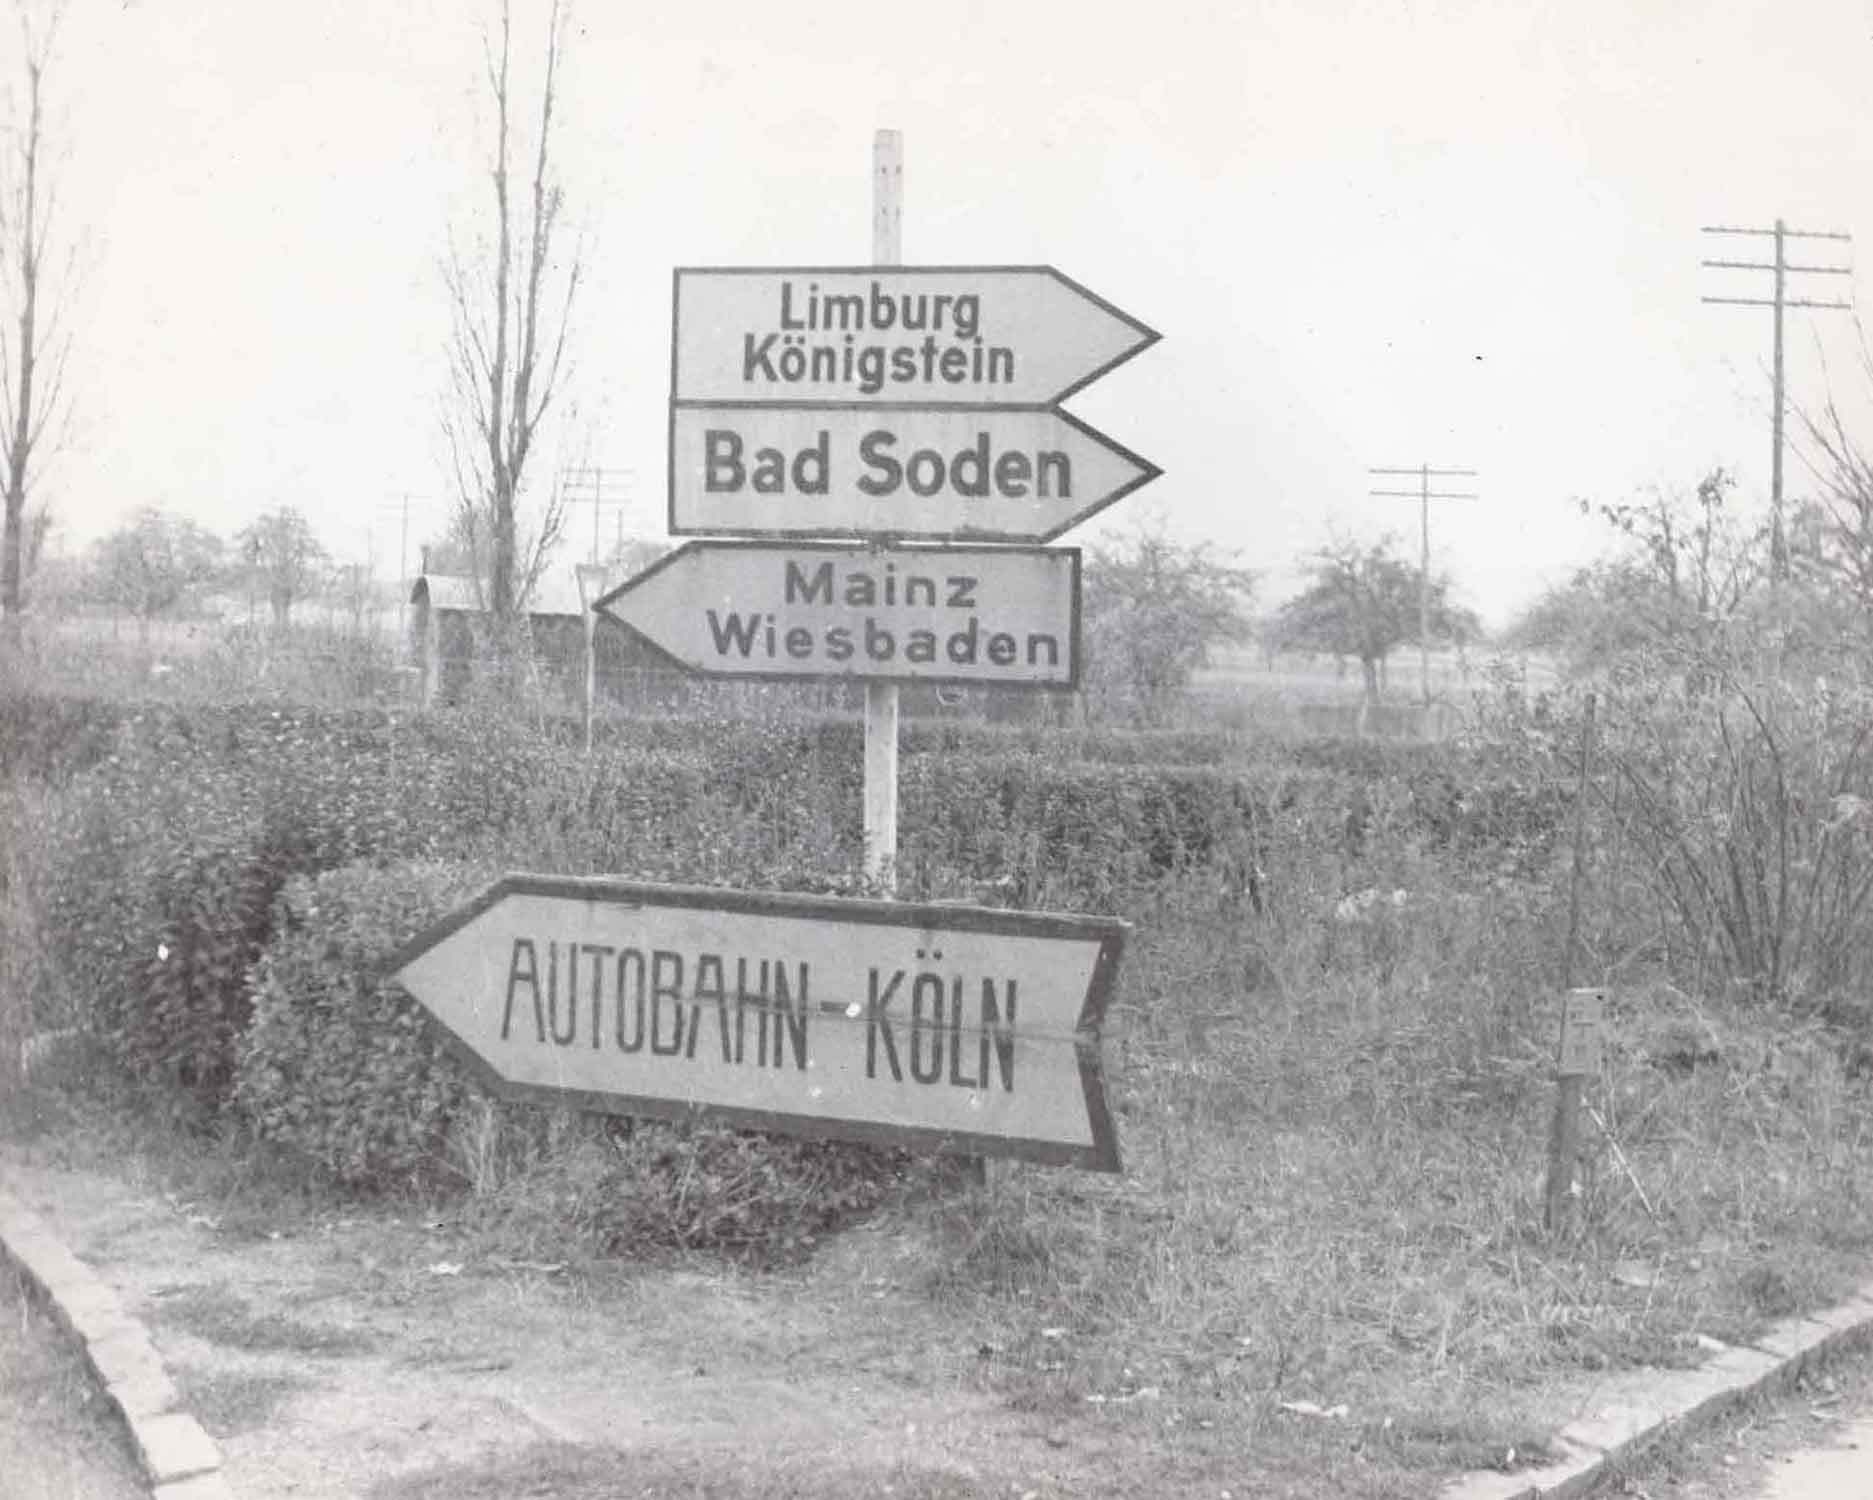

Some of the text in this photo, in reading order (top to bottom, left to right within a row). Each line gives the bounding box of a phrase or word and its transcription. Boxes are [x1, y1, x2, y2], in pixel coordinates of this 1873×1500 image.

[781, 281, 980, 337] Limburg
[743, 332, 1015, 394] Königstein
[703, 429, 1072, 499] Bad Soden
[783, 561, 978, 608] Mainz
[706, 609, 1059, 667] Wiesbaden
